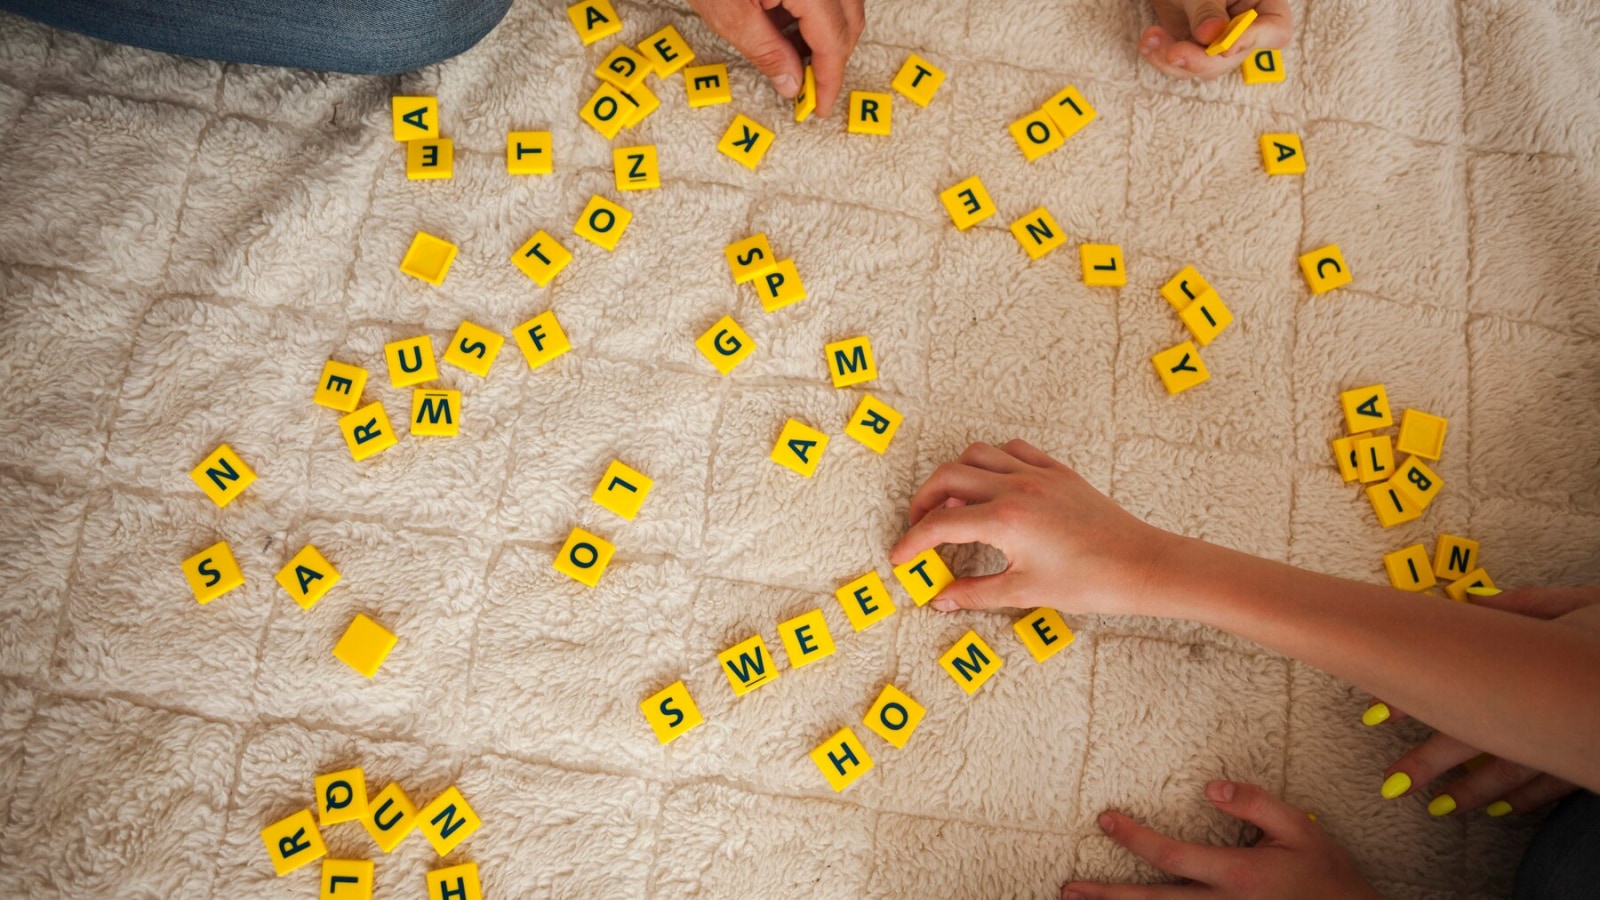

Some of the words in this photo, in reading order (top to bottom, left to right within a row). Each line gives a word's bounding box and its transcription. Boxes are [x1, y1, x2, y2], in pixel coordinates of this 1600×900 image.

[585, 6, 609, 30] A
[653, 38, 679, 63] E
[1254, 50, 1275, 72] D
[608, 56, 636, 78] G
[911, 65, 932, 88] T
[694, 74, 720, 91] E
[402, 106, 429, 131] A
[593, 96, 618, 122] O
[861, 99, 879, 123] R
[1059, 97, 1083, 116] L
[732, 125, 760, 153] K
[1026, 121, 1050, 144] O
[422, 145, 438, 167] E
[516, 142, 542, 160] T
[1273, 142, 1296, 162] A
[958, 188, 981, 215] E
[589, 208, 616, 233] O
[1025, 218, 1054, 245] N
[525, 242, 551, 265] T
[737, 247, 764, 266] S
[1093, 257, 1117, 271] L
[1317, 257, 1341, 279] C
[765, 272, 785, 298] P
[459, 337, 486, 359] S
[528, 324, 546, 352] F
[714, 329, 742, 356] G
[398, 345, 423, 373] U
[834, 345, 868, 376] M
[1171, 353, 1198, 373] Y
[326, 374, 353, 395] E
[1356, 395, 1383, 418] A
[353, 417, 382, 445] R
[860, 409, 890, 435] R
[787, 439, 817, 464] A
[1370, 447, 1385, 472] L
[205, 458, 240, 491] N
[607, 476, 638, 493] L
[1407, 466, 1433, 492] B
[569, 542, 599, 569] O
[1448, 544, 1471, 574] N
[197, 558, 221, 588] S
[295, 565, 324, 595] A
[659, 559, 934, 728] SWEET
[827, 617, 1058, 776] HOME
[325, 780, 353, 812] Q
[373, 798, 404, 831] U
[430, 803, 466, 840] N
[278, 827, 311, 859] R
[329, 875, 359, 894] L
